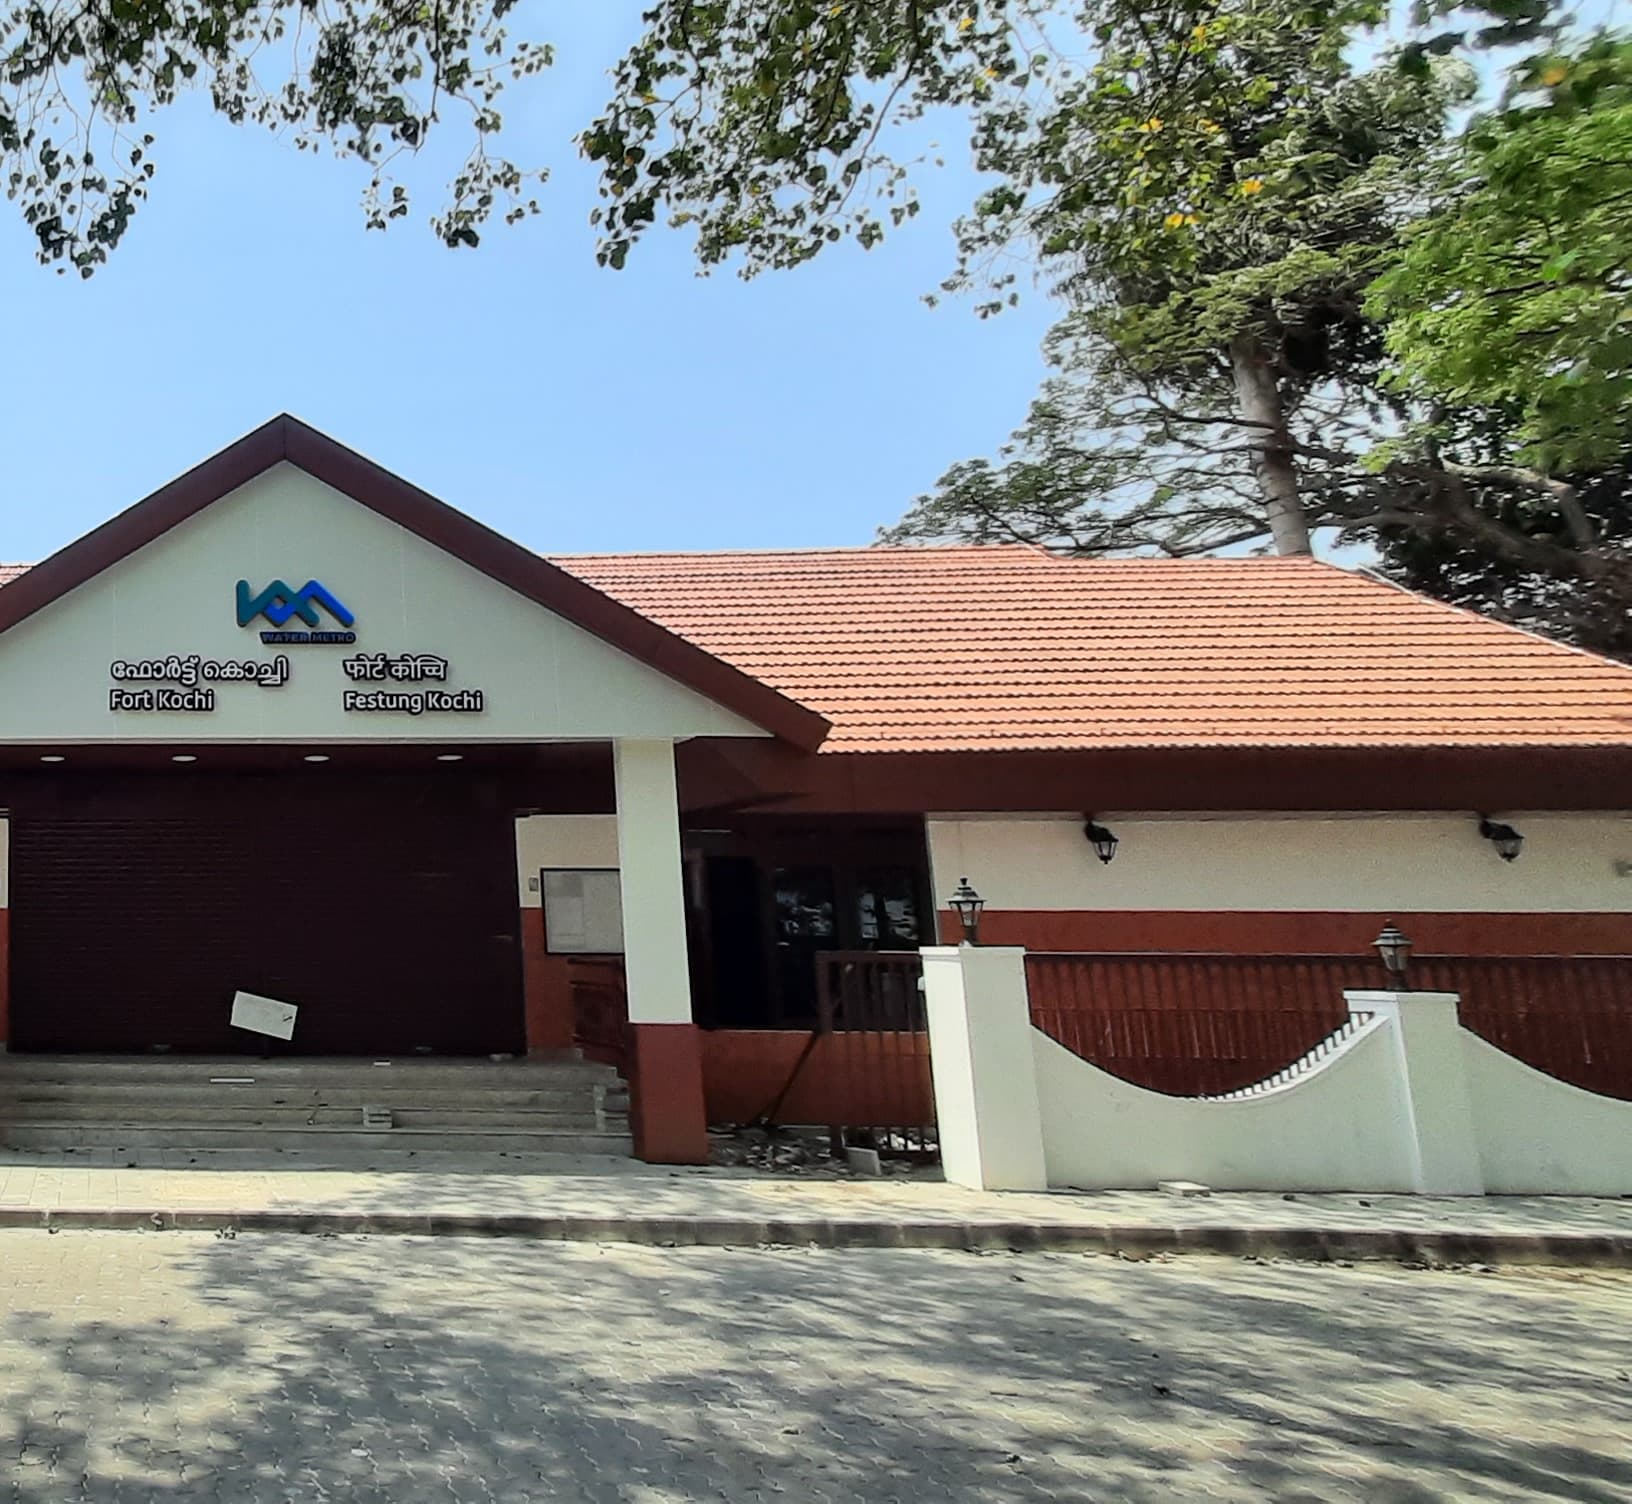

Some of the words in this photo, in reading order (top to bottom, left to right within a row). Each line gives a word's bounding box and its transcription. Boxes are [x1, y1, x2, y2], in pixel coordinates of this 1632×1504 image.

[111, 655, 200, 686] ഫോർട്ട്
[202, 655, 288, 686] കൊച്ചി
[344, 654, 386, 679] फोर्ट
[389, 655, 446, 679] कोच्चि
[111, 690, 152, 709] Fort
[157, 690, 213, 709] Kochi
[344, 691, 423, 714] Festung
[426, 691, 482, 710] Kochi
